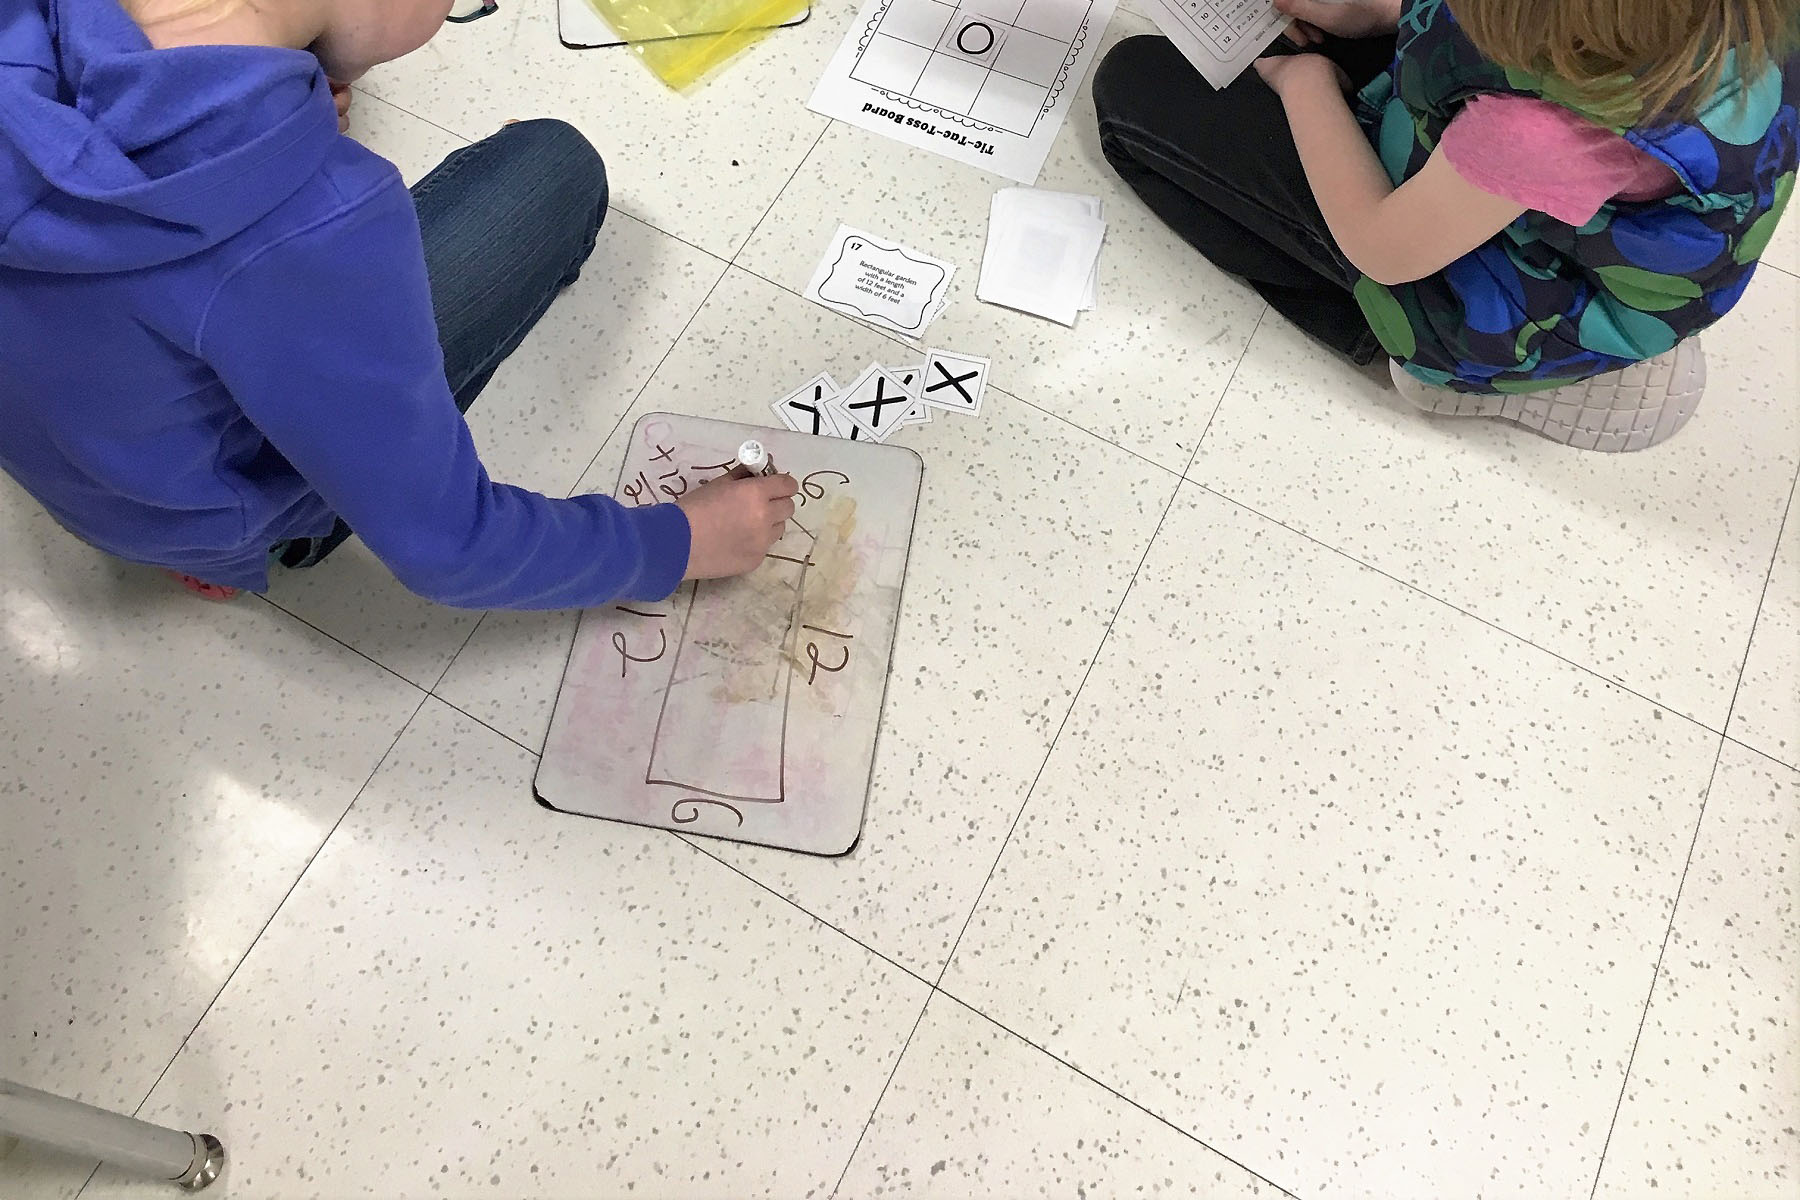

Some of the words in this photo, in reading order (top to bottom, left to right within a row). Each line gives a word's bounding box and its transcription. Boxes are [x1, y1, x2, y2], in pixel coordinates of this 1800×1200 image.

[862, 102, 905, 124] Board
[906, 117, 994, 155] Tic-Tac-Toss
[860, 260, 894, 277] Rectangular
[895, 275, 917, 285] garden
[885, 279, 904, 289] length
[855, 285, 873, 294] width
[926, 361, 978, 403] X
[849, 377, 907, 427] X
[659, 468, 687, 500] 12
[802, 470, 851, 500] 6
[612, 606, 667, 678] 12
[802, 625, 853, 685] 12
[671, 798, 743, 827] 6
